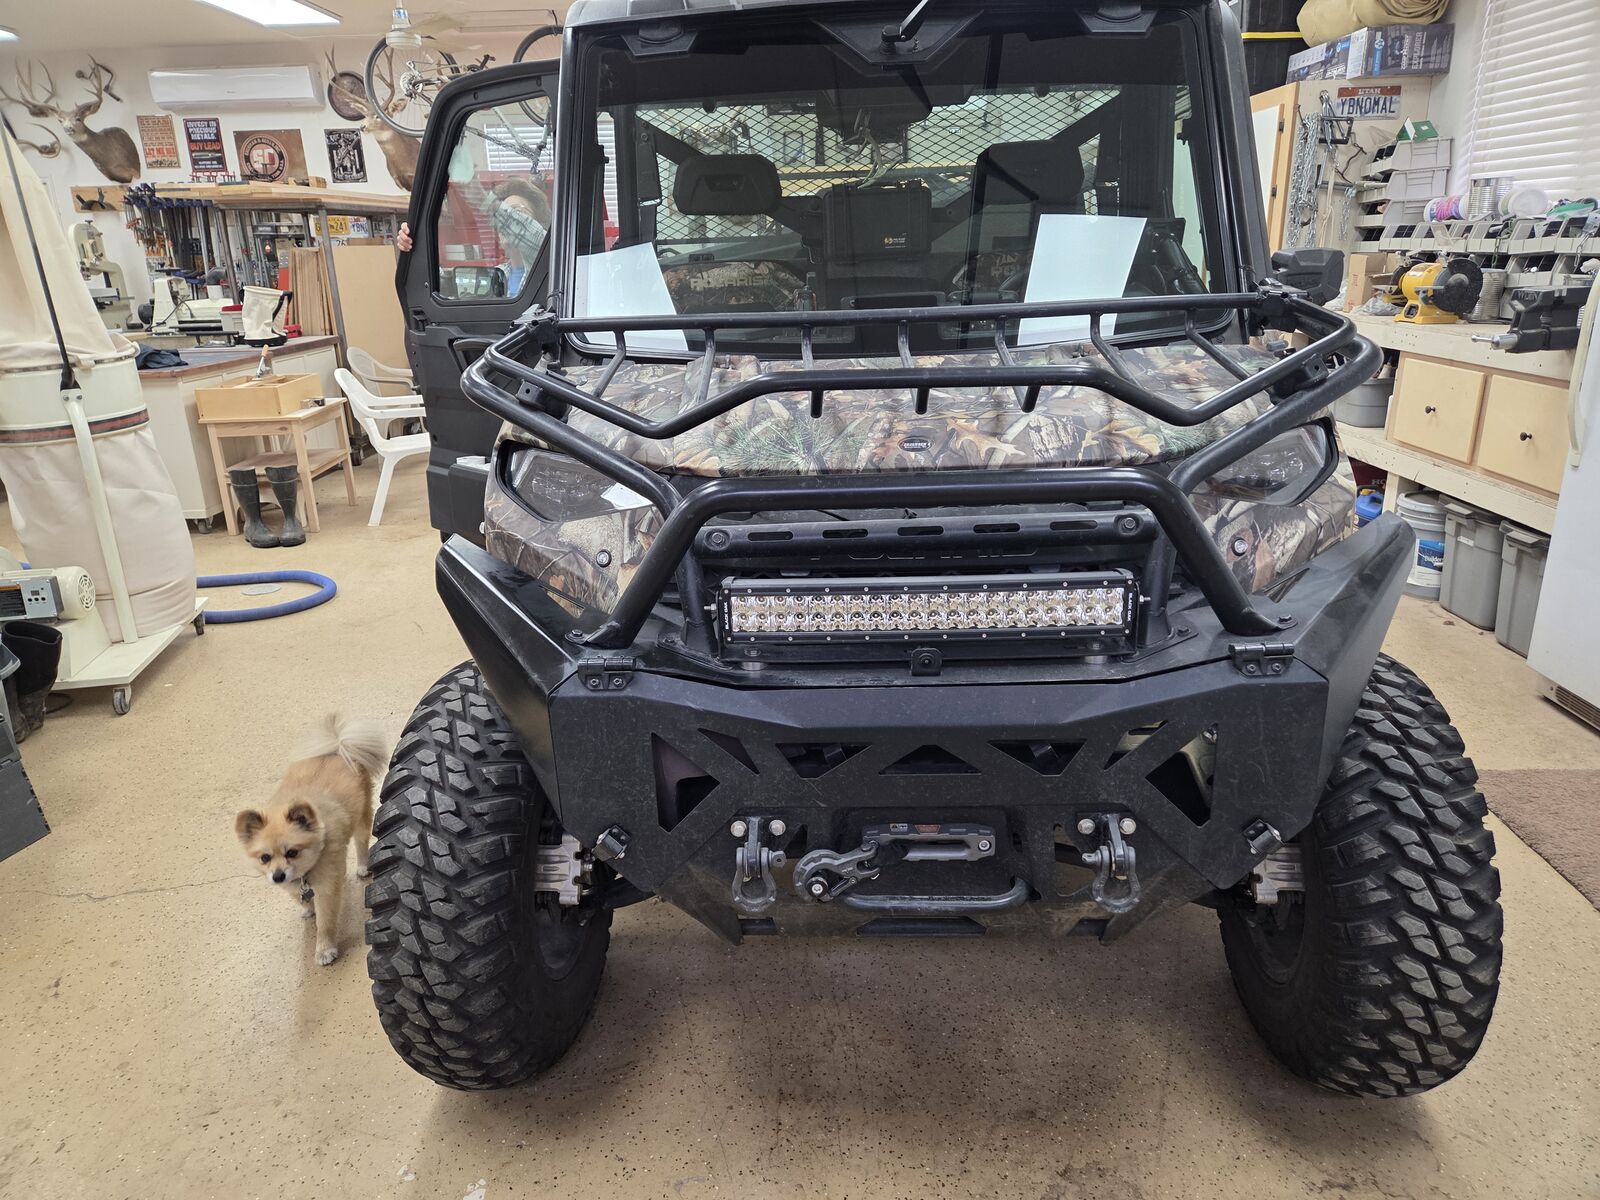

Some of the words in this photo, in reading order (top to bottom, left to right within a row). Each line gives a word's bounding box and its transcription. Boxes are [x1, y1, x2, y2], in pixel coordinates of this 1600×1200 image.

[1411, 31, 1423, 70] EXPLORER
[1340, 97, 1396, 115] YBNOMAL
[190, 142, 204, 150] BUY
[204, 141, 221, 149] LEAD
